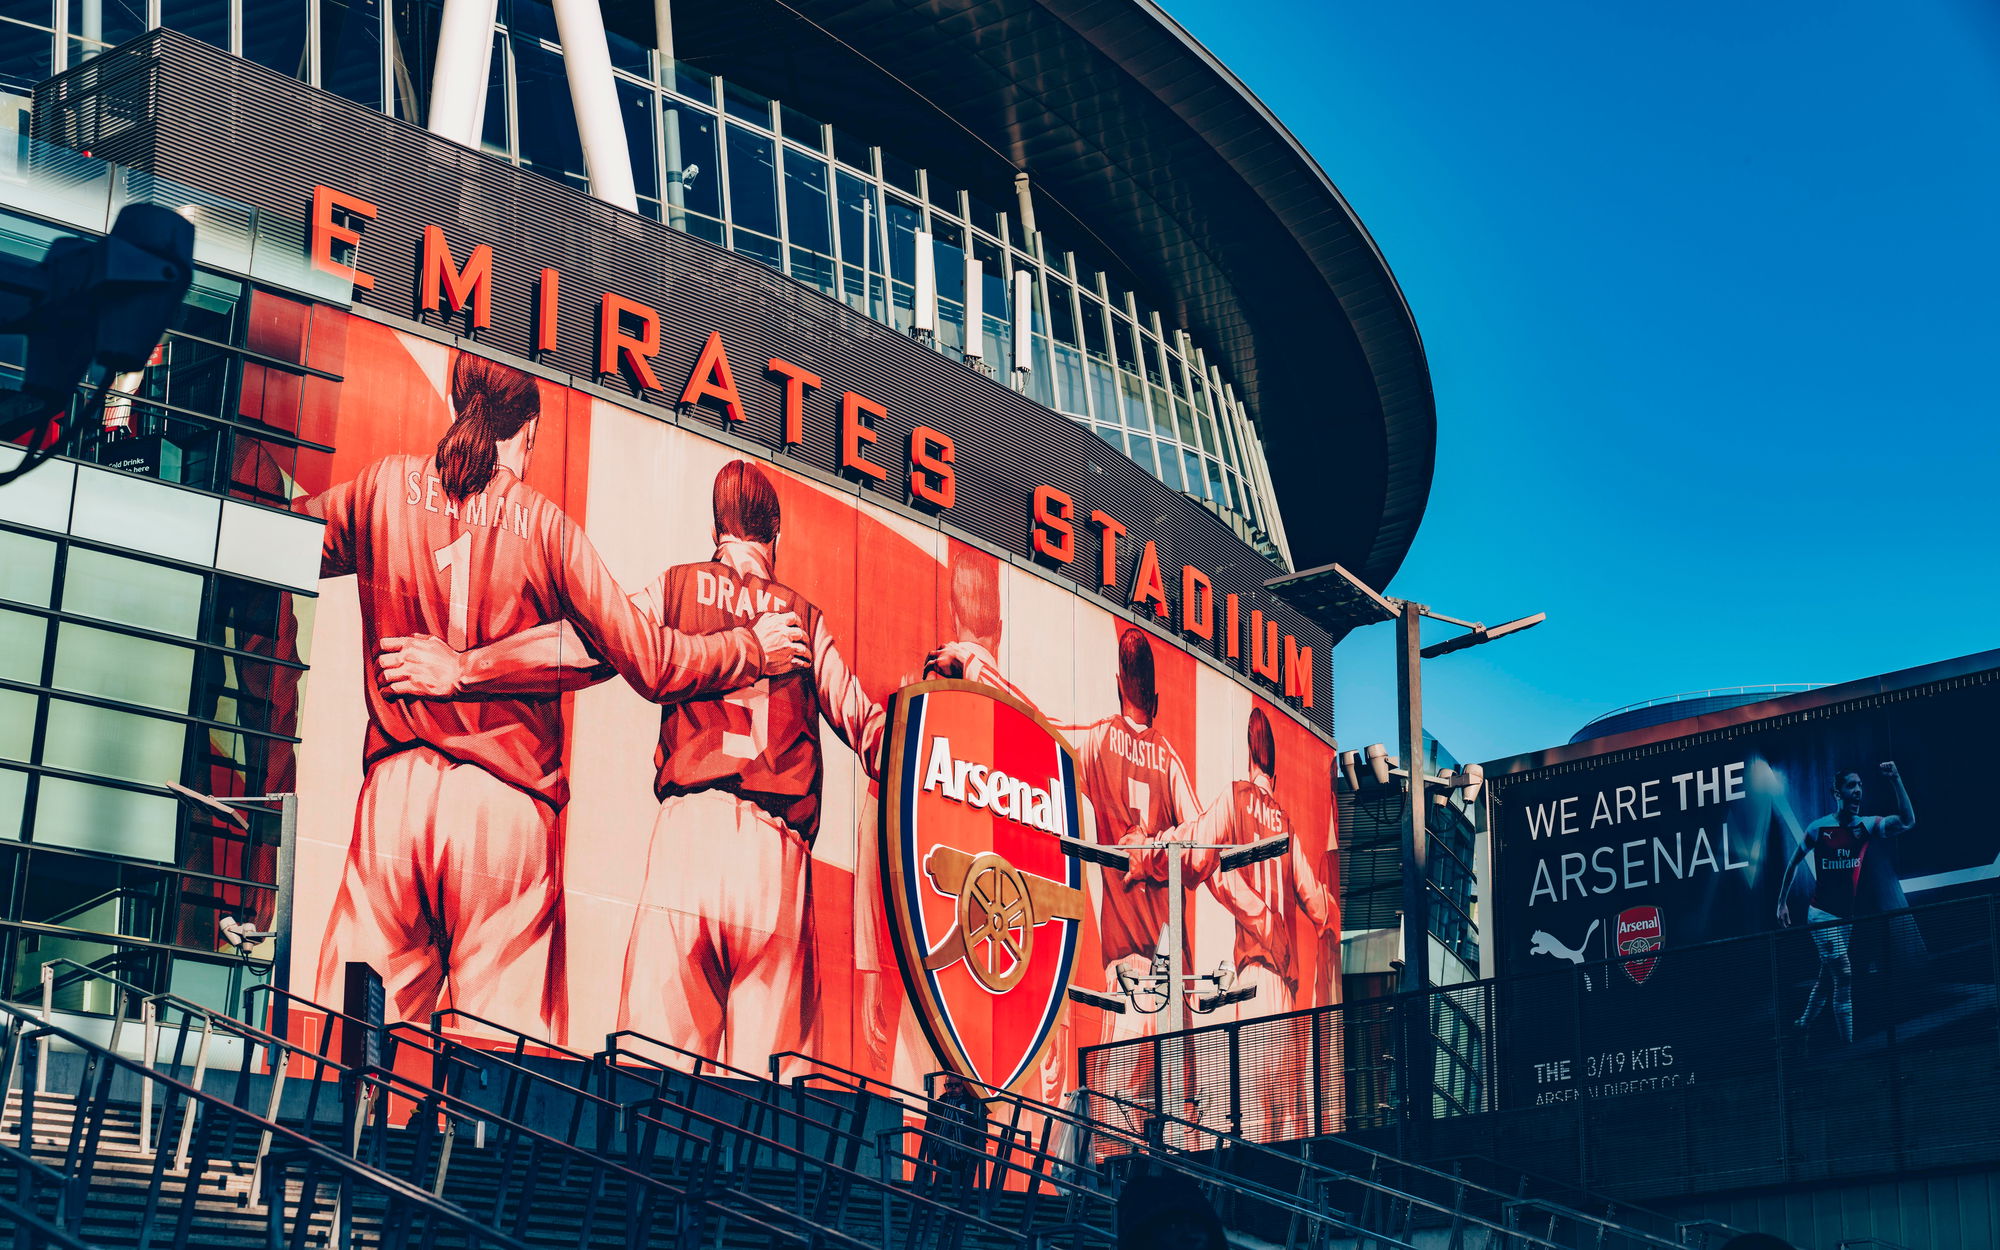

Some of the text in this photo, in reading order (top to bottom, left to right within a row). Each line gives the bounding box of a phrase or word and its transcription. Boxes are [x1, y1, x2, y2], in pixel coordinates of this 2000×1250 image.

[123, 457, 145, 467] Drinks
[312, 184, 1313, 708] EMIRATES STADIUM
[133, 465, 150, 473] here
[406, 471, 529, 540] SEAMAN
[434, 529, 473, 651] 1
[1109, 726, 1167, 775] ROCASTLE
[923, 735, 1064, 837] Arsenal
[1525, 761, 1747, 841] WE ARE THE
[1246, 793, 1283, 833] JAMES
[1528, 822, 1750, 907] ARSENAL
[1822, 857, 1861, 870] Emirates
[1837, 848, 1851, 858] Fly
[1618, 915, 1659, 935] Arsenal
[1533, 1059, 1572, 1084] THE
[1631, 1045, 1674, 1071] KITS
